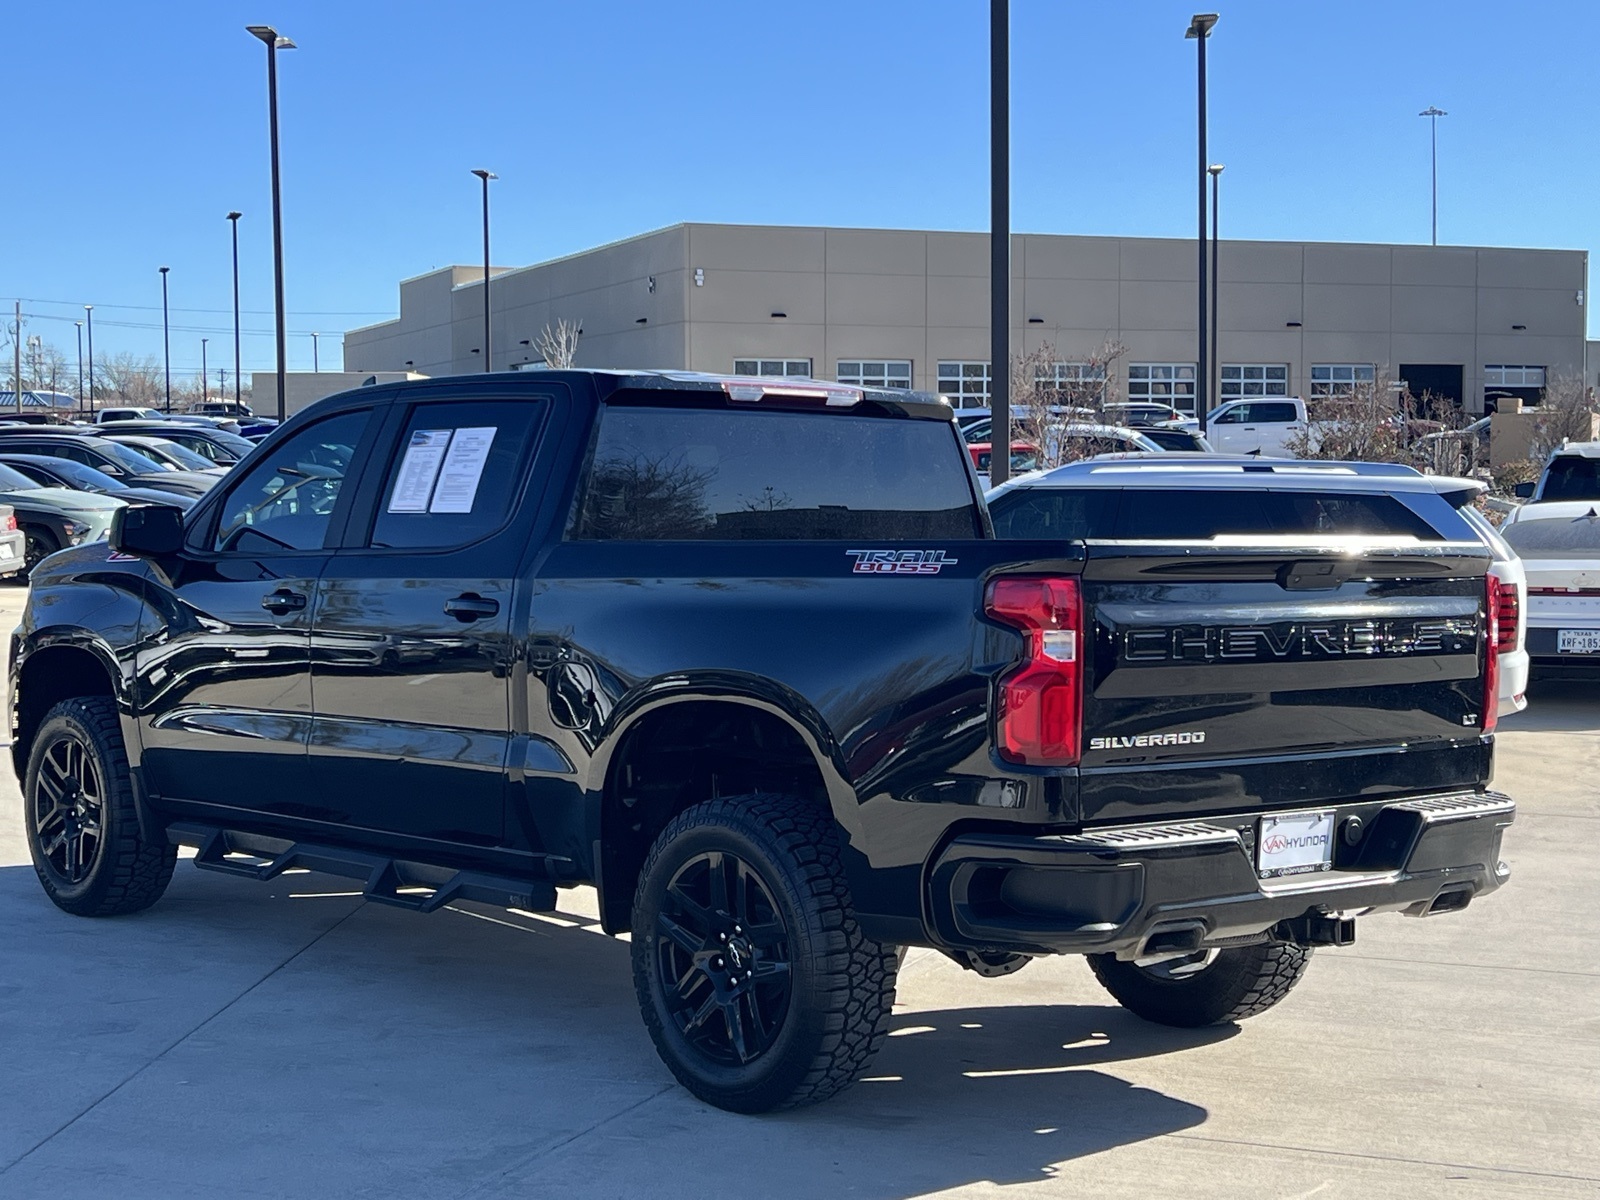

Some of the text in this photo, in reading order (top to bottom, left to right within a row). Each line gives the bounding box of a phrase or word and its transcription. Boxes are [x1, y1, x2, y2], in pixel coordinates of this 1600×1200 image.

[845, 550, 958, 564] TRAIL
[853, 562, 941, 574] BOSS
[1462, 713, 1478, 726] LT
[1089, 731, 1206, 750] SILVERADO
